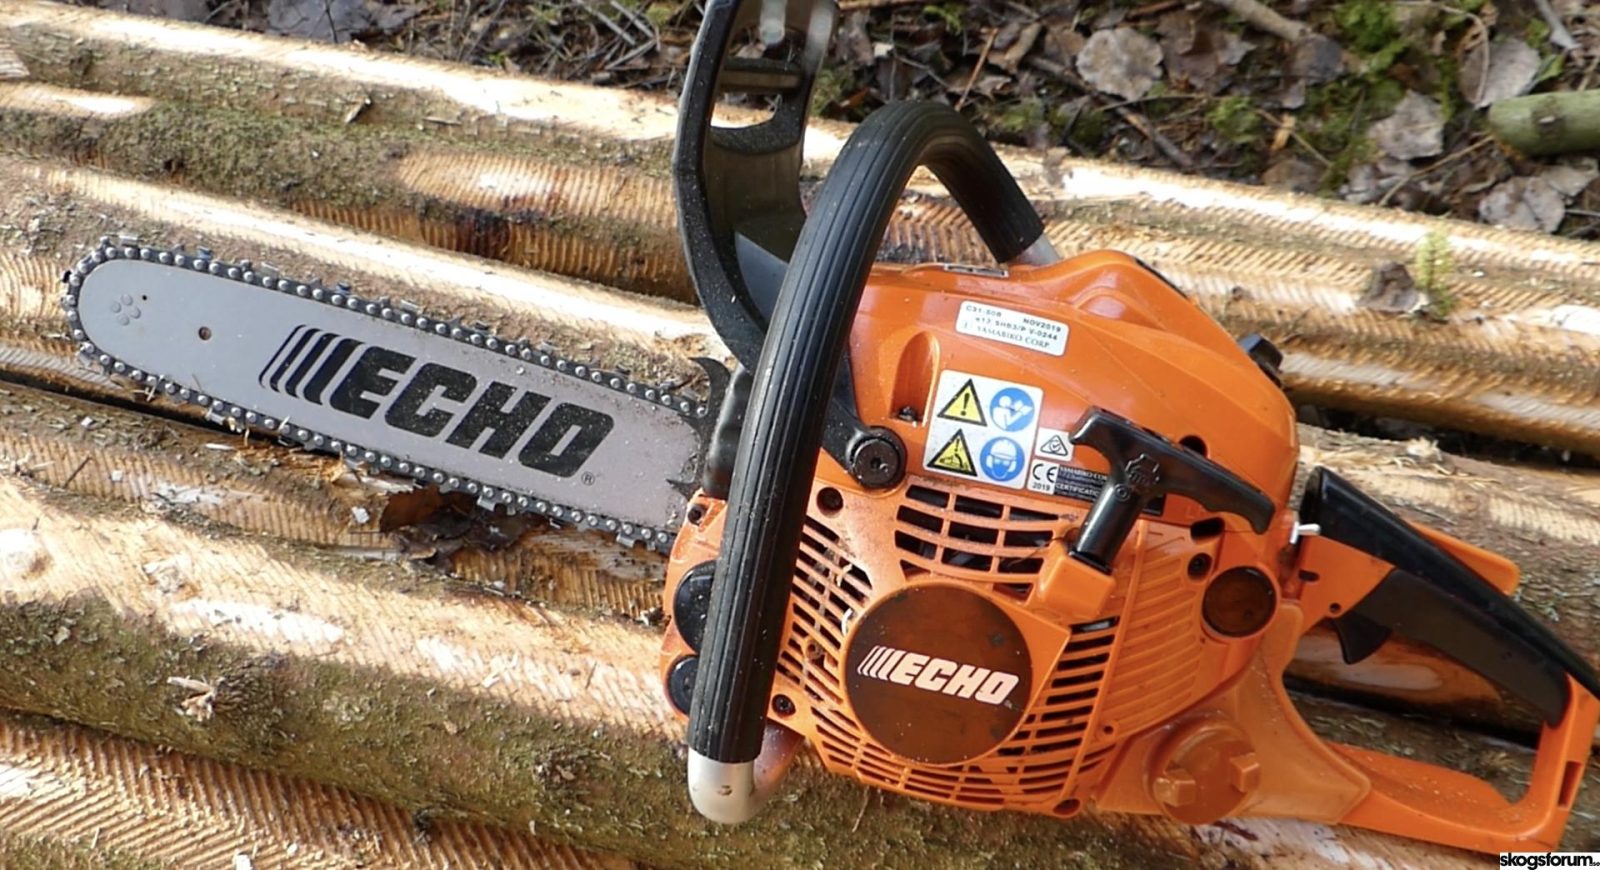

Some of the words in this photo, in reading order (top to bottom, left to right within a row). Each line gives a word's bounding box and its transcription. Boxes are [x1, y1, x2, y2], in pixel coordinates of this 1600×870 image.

[1023, 318, 1062, 334] NOV2019
[1029, 328, 1058, 341] V-0244
[977, 326, 1023, 342] YAMABIKO
[1025, 337, 1050, 348] CORP
[329, 346, 615, 478] ECHO
[1032, 481, 1051, 492] 2019
[889, 652, 1019, 705] ECHO
